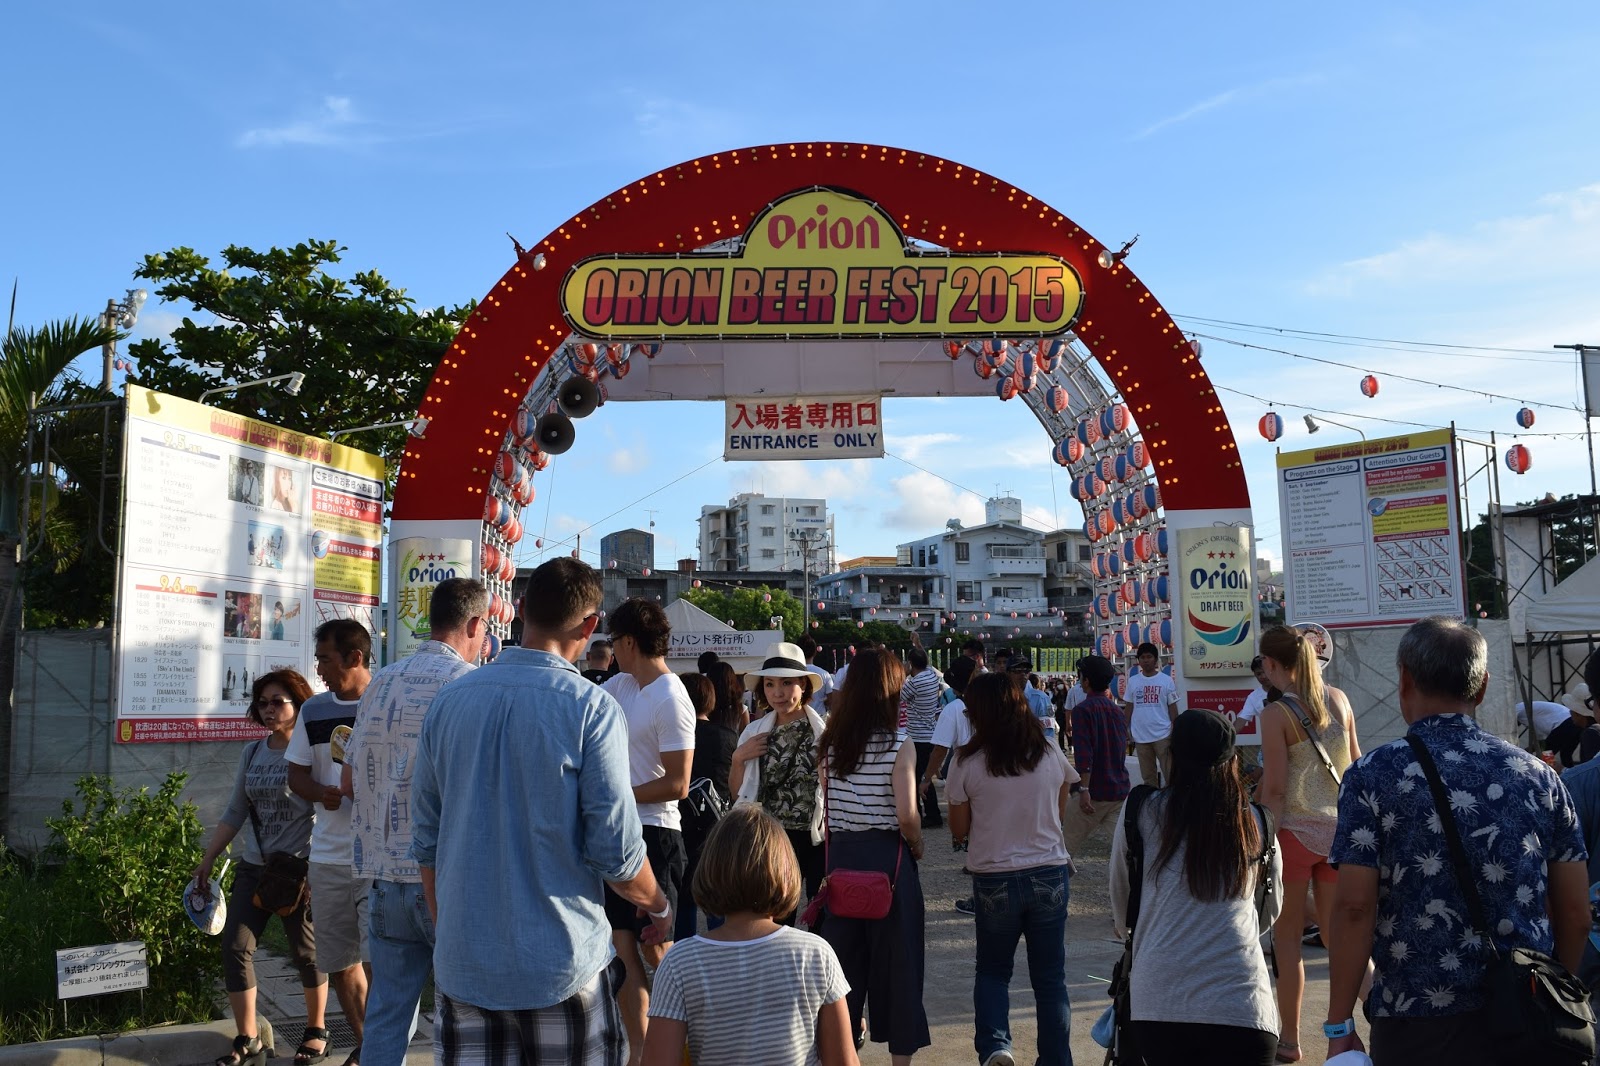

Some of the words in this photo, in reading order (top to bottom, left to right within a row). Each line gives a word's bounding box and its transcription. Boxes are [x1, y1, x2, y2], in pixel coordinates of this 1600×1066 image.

[767, 204, 880, 250] Orion
[582, 267, 724, 327] ORION
[727, 266, 839, 326] BEER
[843, 266, 947, 325] FEST
[949, 265, 1064, 324] 2015
[732, 402, 878, 430] 入場者専用口
[210, 411, 249, 442] ORION
[249, 421, 279, 449] BEER
[278, 430, 305, 457] FEST
[304, 437, 333, 464] 2015
[730, 434, 819, 450] ENTRANCE
[834, 431, 878, 449] ONLY
[1368, 457, 1397, 467] Attention
[1407, 454, 1418, 462] Our
[1419, 451, 1441, 461] Guests
[1289, 468, 1316, 479] Programs
[1336, 463, 1353, 473] Stage
[1368, 475, 1404, 485] unaccompanied
[409, 562, 456, 583] Orion
[1190, 562, 1248, 590] Orion
[160, 574, 182, 592] 9.6
[183, 585, 197, 594] SUN
[1201, 601, 1227, 612] DRAFT
[1228, 601, 1243, 612] BEER
[1190, 644, 1206, 656] お酒
[1143, 685, 1162, 694] DRAFT
[1143, 694, 1159, 703] BEER
[273, 765, 289, 774] CAR
[280, 811, 294, 821] ALL
[64, 963, 89, 976] 株式会社
